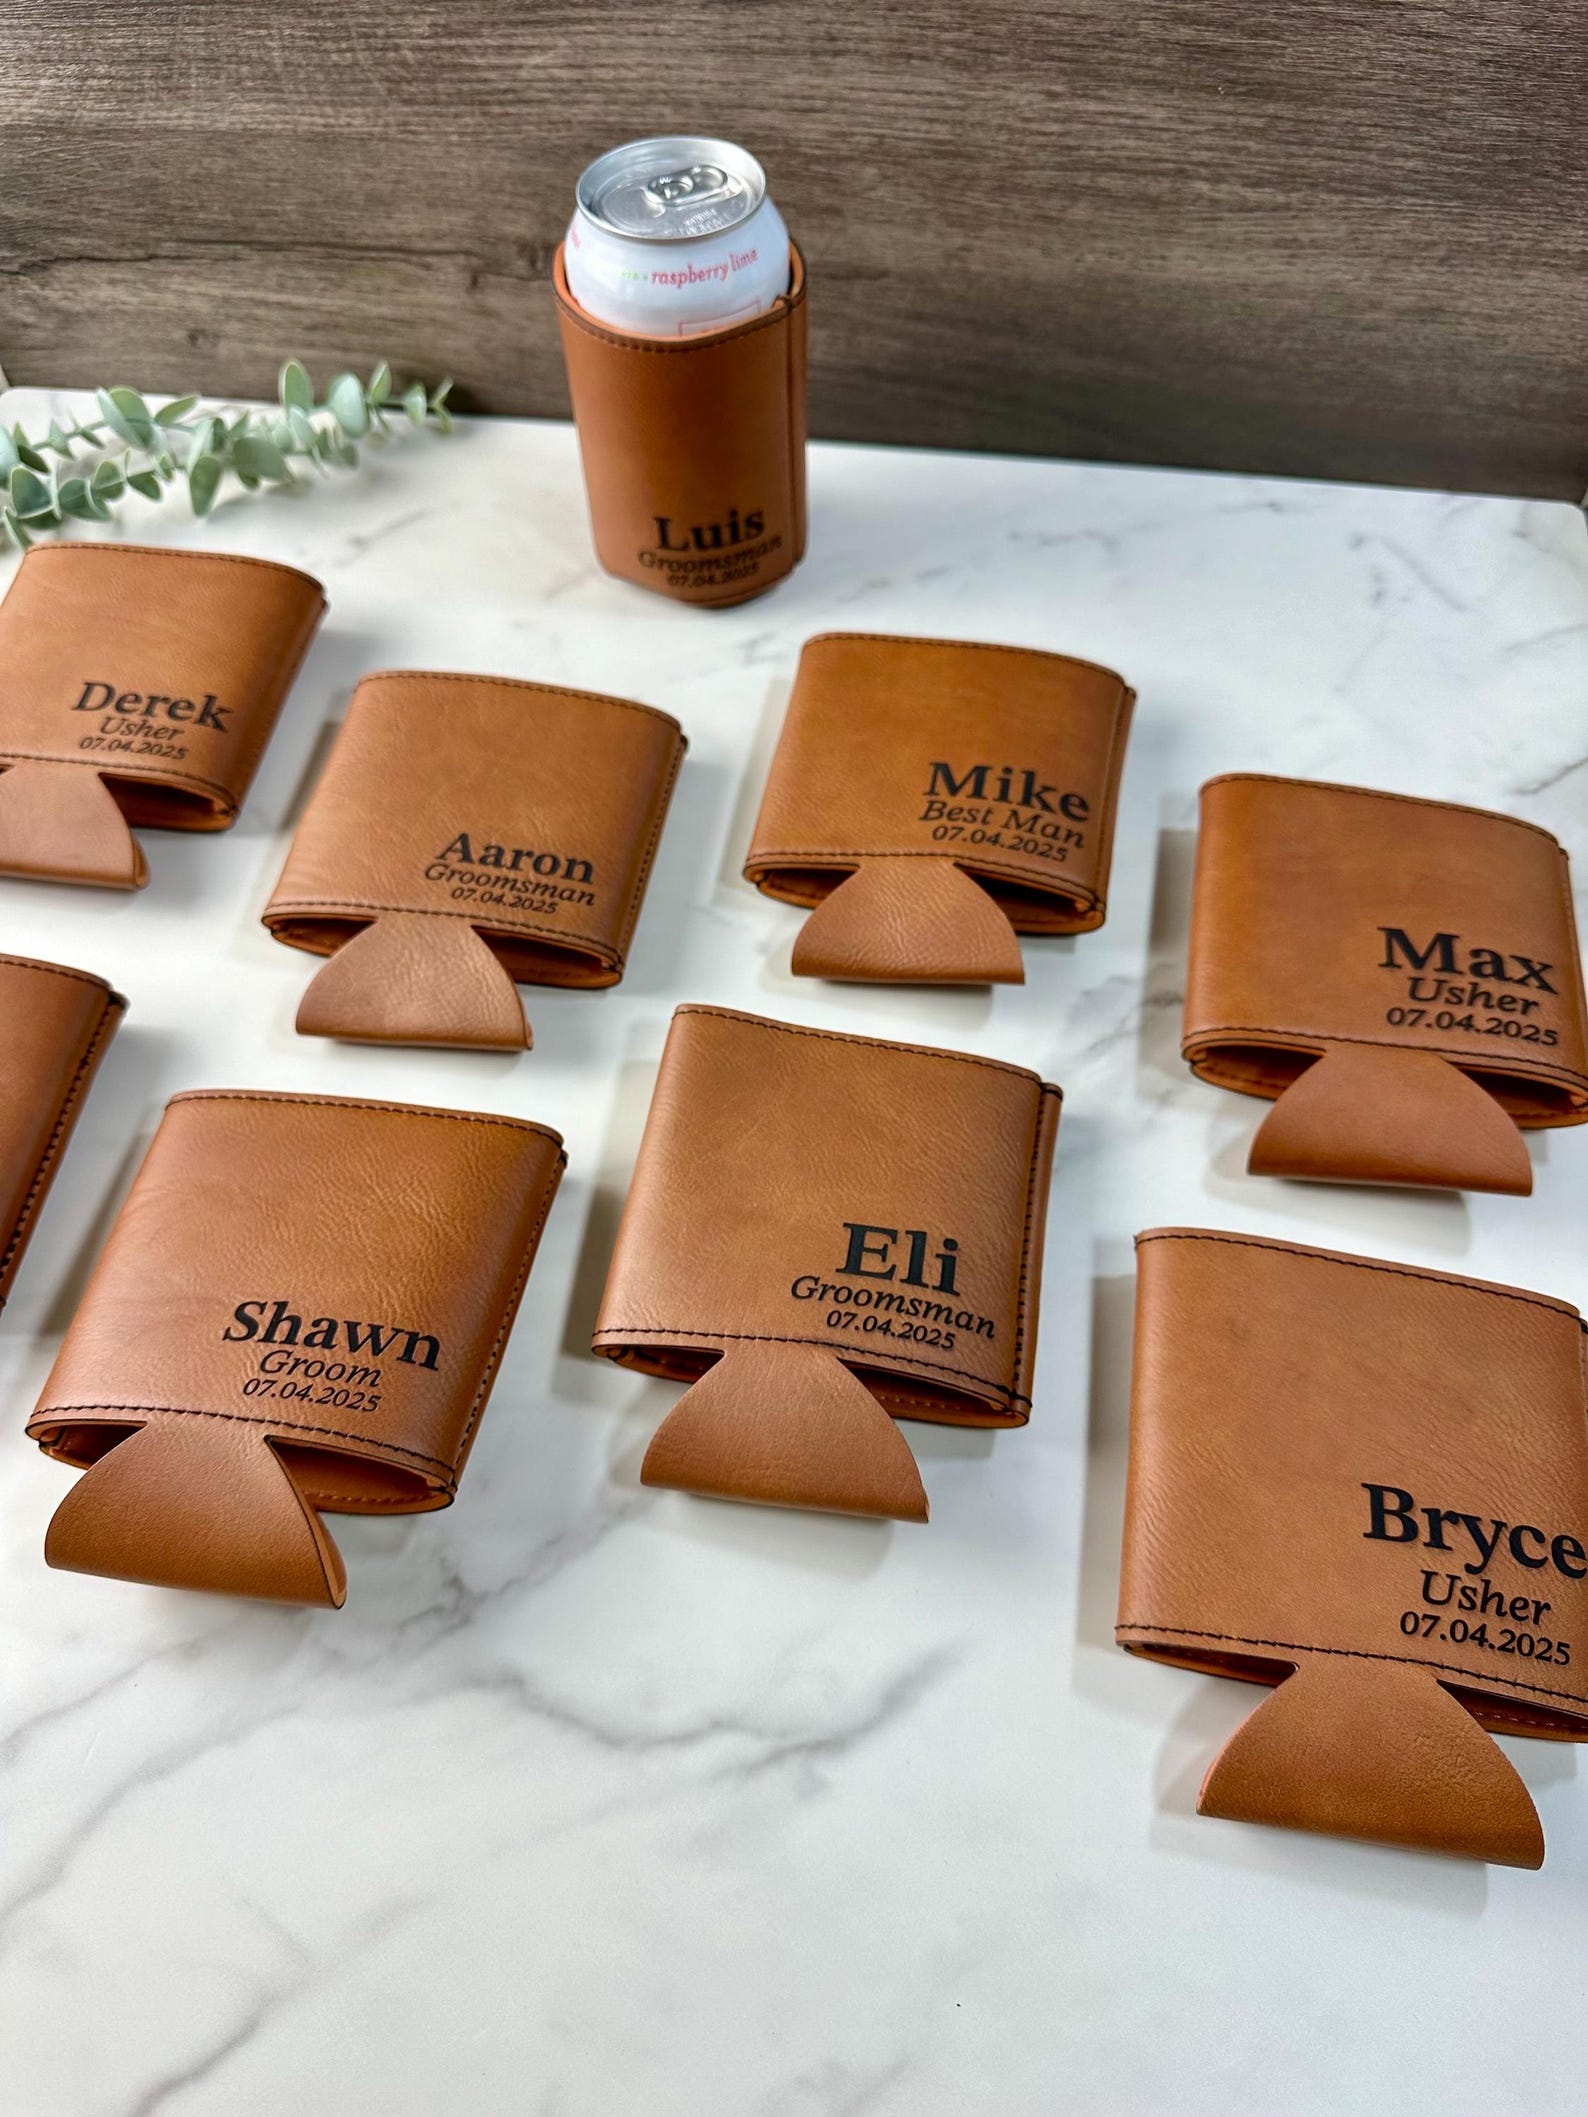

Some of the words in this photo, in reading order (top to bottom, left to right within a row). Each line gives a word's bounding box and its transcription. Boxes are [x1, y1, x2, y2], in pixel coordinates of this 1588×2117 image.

[651, 262, 729, 290] raspberry
[729, 248, 759, 274] lime
[653, 509, 765, 552] Luis
[637, 534, 782, 573] Groomsman
[72, 681, 233, 733] Derek
[100, 716, 185, 741] Usher
[79, 736, 189, 760] 07.04.2025
[923, 762, 1090, 823] Mike
[918, 800, 995, 826] Best
[999, 809, 1085, 849] Man
[932, 825, 1069, 863] 07.04.2025
[434, 832, 594, 885] Aaron
[424, 862, 597, 906] Groomsman
[451, 887, 559, 914] 07.04.2025
[1377, 926, 1559, 995] Max
[1407, 976, 1540, 1016] Usher
[1386, 1007, 1559, 1047] 07.04.2025
[835, 1222, 961, 1297] Eli
[790, 1275, 996, 1339] Groomsman
[222, 1300, 442, 1372] Shawn
[826, 1309, 956, 1350] 07.04.2025
[259, 1349, 382, 1388] Groom
[242, 1378, 382, 1412] 07.04.2025
[1360, 1482, 1588, 1579] Bryce
[1420, 1569, 1551, 1625] Usher
[1400, 1611, 1571, 1666] 07.04.2025
